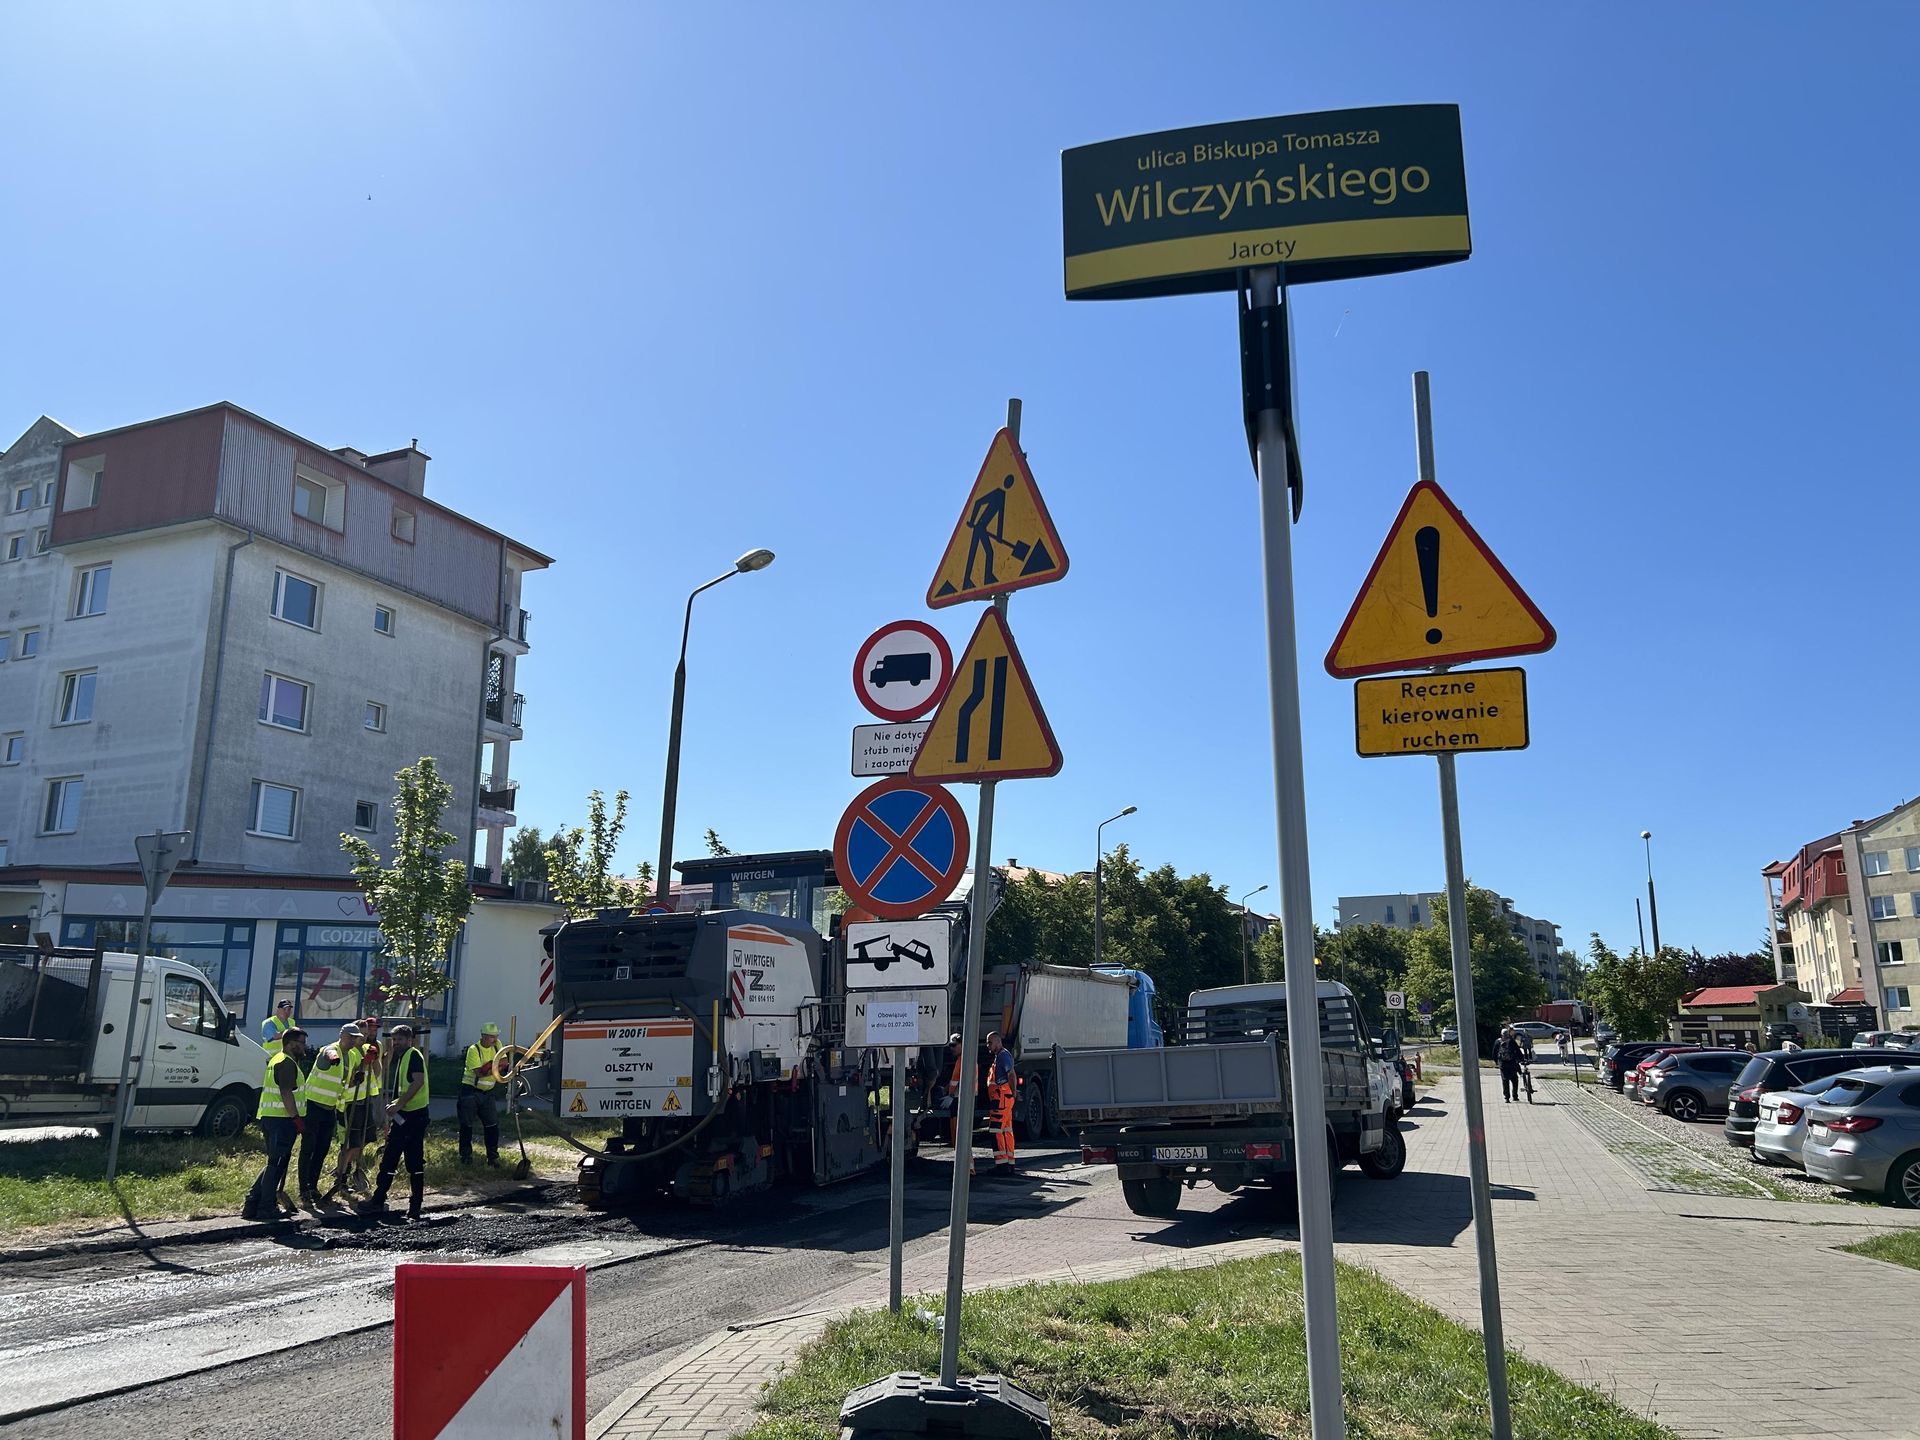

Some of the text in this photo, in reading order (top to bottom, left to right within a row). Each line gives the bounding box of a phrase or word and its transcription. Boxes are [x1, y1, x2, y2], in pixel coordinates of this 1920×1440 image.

[1137, 129, 1380, 171] ulica Biskupa Tomasza
[1095, 162, 1431, 227] Wilczyńskiego
[1228, 237, 1297, 260] Jaroty
[1401, 681, 1475, 701] Ręczne
[1382, 702, 1499, 725] kierowanie
[874, 731, 891, 741] Nie
[1402, 730, 1479, 748] ruchem
[863, 743, 921, 756] służb miejs
[731, 869, 775, 881] WIRTGEN
[105, 892, 299, 914] ATEKA
[744, 953, 775, 968] WIRTGEN
[604, 1062, 653, 1073] OLSZTYN
[600, 1099, 652, 1111] WIRTGEN
[1175, 1148, 1205, 1158] 325AJ
